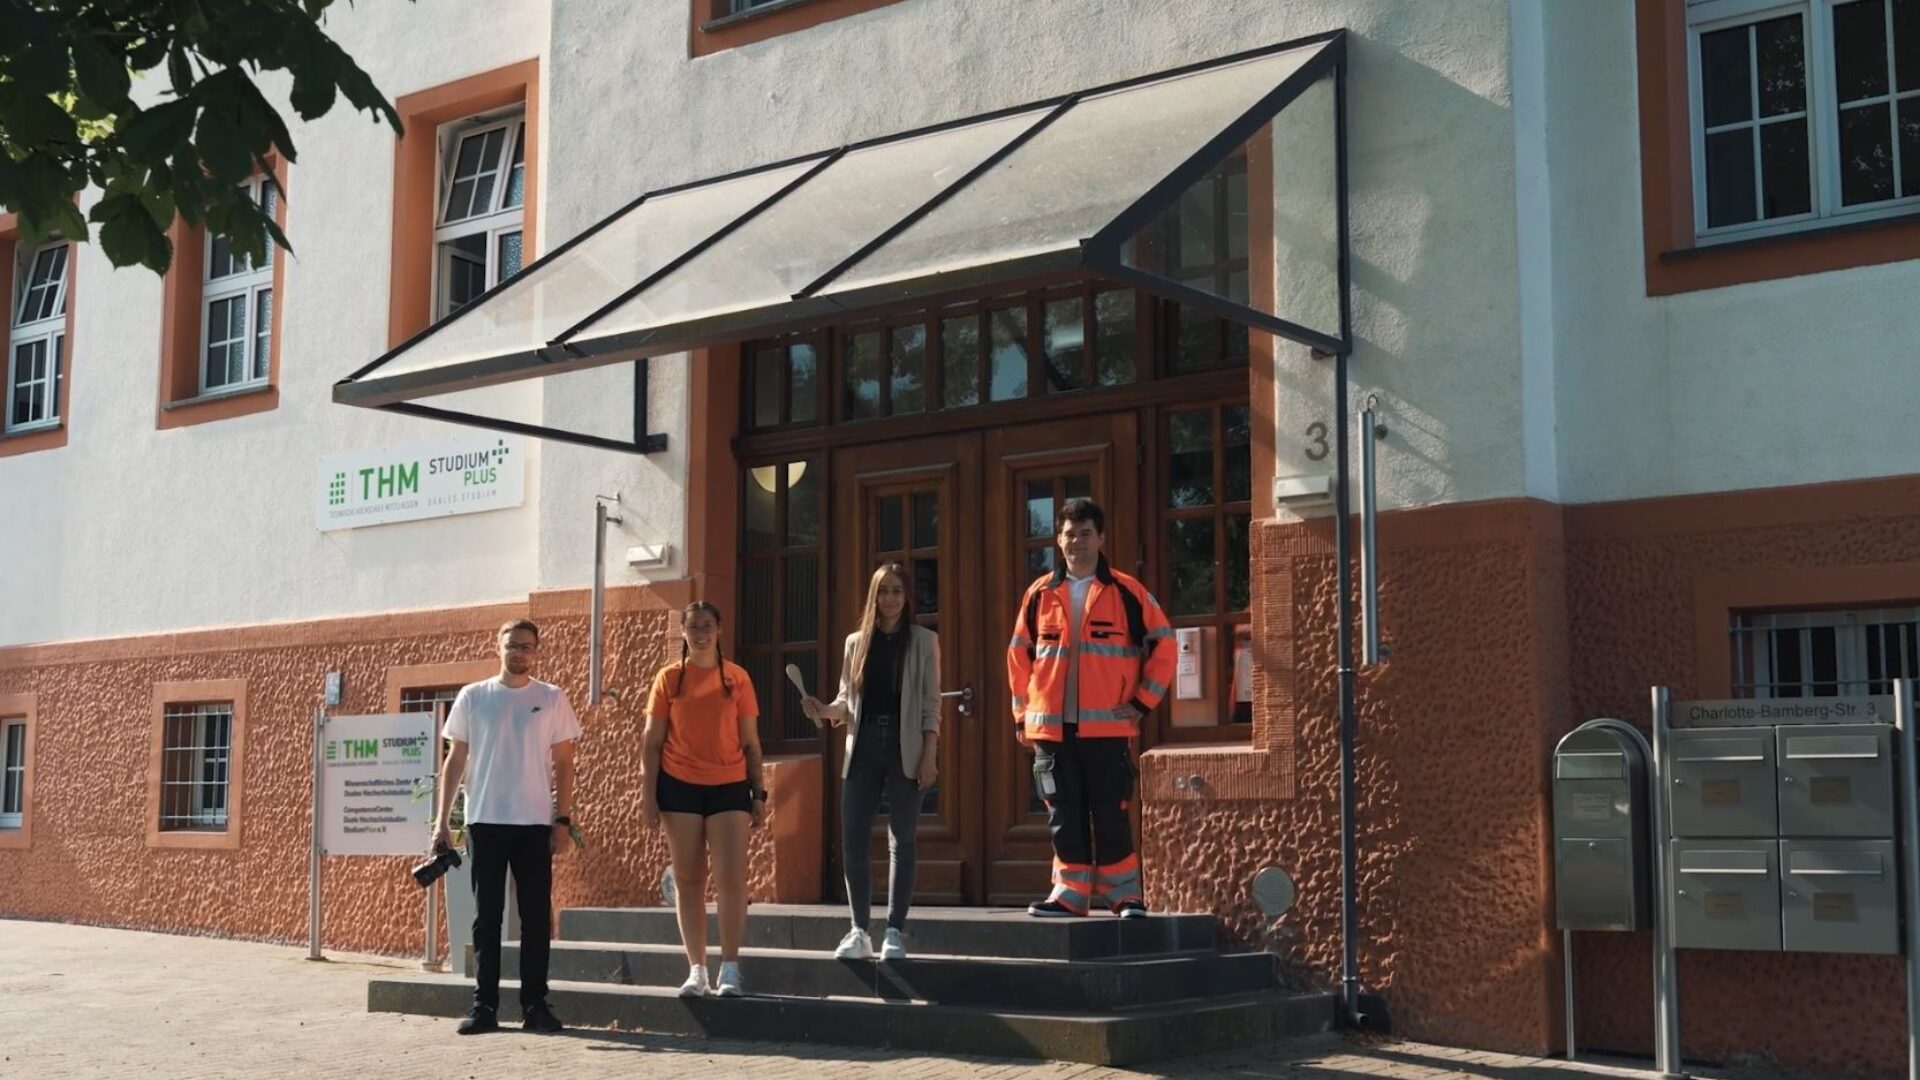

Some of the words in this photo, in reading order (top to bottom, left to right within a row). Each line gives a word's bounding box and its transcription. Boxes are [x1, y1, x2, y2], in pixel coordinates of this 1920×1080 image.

[1305, 422, 1330, 461] 3
[429, 451, 489, 475] STUDIUM
[359, 461, 419, 500] THM
[464, 467, 497, 487] PLUS
[1689, 702, 1861, 720] Charlotte-Bamberg-Str.
[1866, 702, 1876, 716] 3
[343, 739, 378, 759] THM
[382, 737, 417, 748] STUDIUM
[401, 746, 422, 757] PLUS
